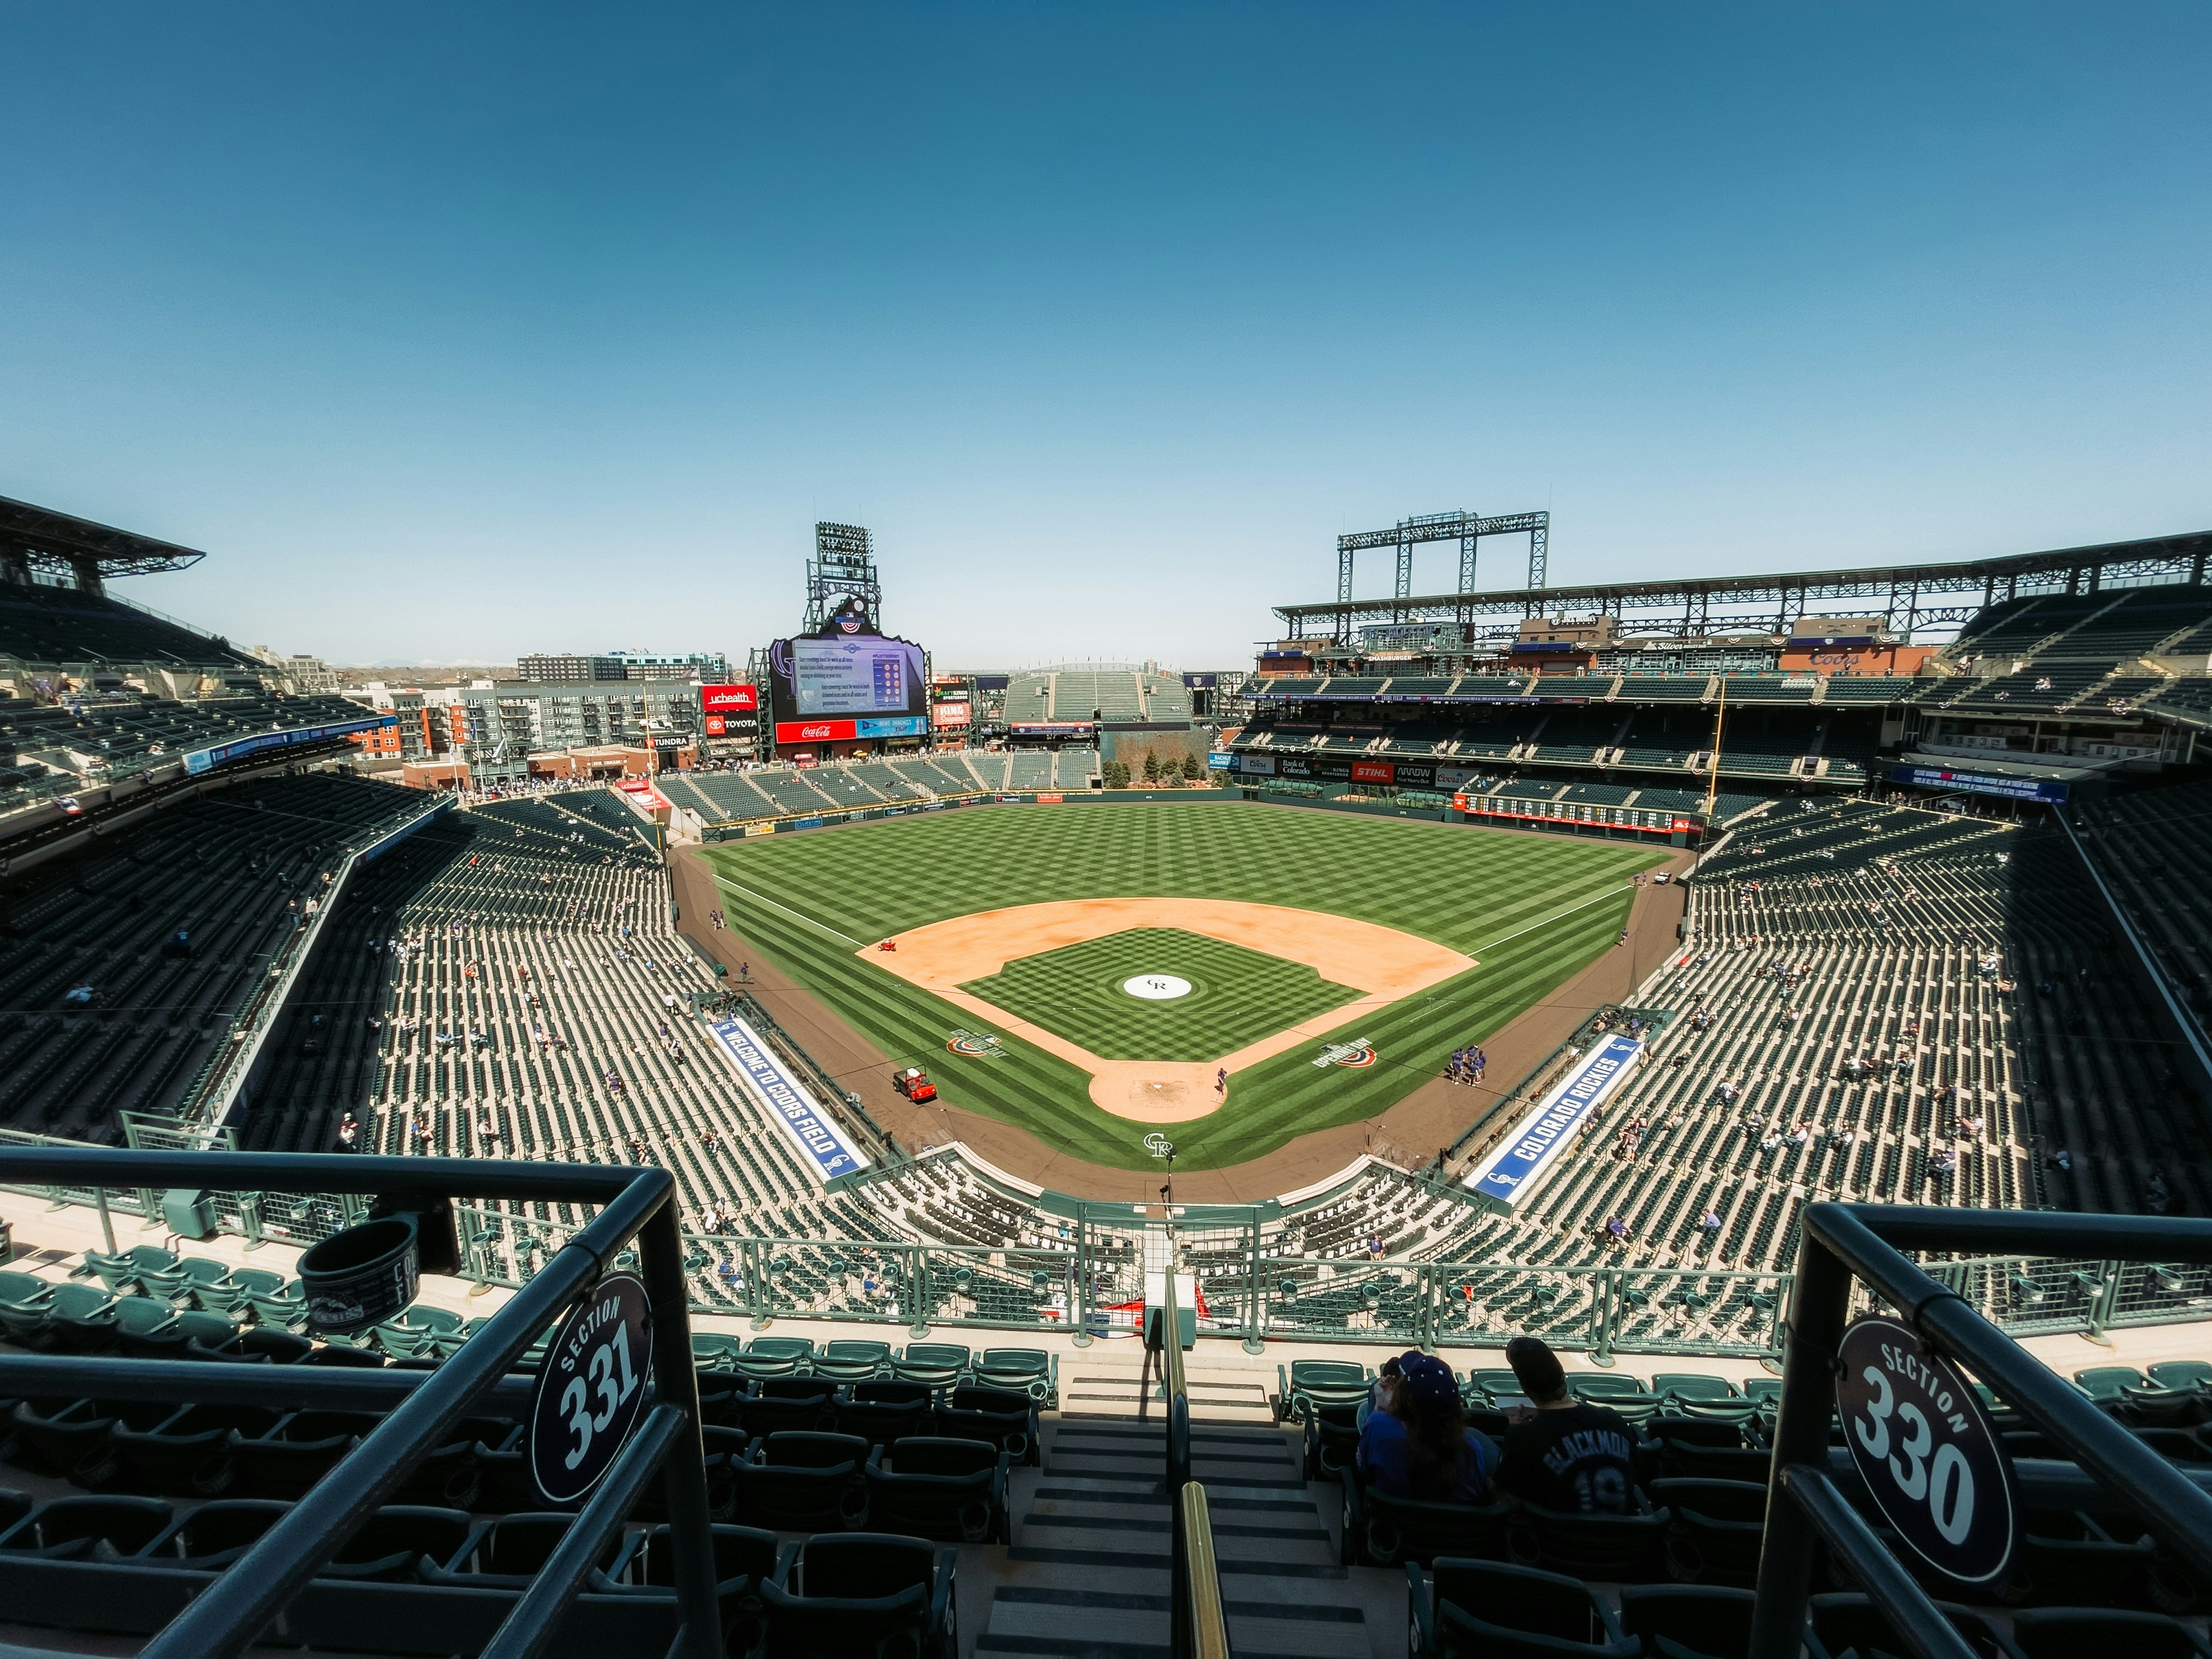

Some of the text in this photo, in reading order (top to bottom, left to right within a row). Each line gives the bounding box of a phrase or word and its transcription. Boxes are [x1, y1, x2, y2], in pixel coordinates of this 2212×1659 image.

[1657, 642, 1683, 650] Silver
[1810, 653, 1859, 666] Coors
[711, 692, 749, 702] uchealth
[940, 705, 964, 715] KING
[725, 720, 758, 728] TOYOTA
[654, 737, 687, 746] TUNDRA
[1283, 766, 1310, 775] Colorado
[1357, 768, 1388, 777] STIHL
[1437, 773, 1459, 783] Coors
[621, 781, 644, 789] uchealth
[950, 1028, 1011, 1058] OPENING DAY
[1311, 1037, 1373, 1068] OPENING DAY
[724, 1030, 837, 1154] WELCOME TO COORS FIELD
[1513, 1057, 1620, 1162] COLORADO ROCKIES
[561, 1295, 621, 1372] SECTION
[560, 1319, 639, 1471] 331
[1881, 1343, 1969, 1434] SECTION
[1542, 1430, 1630, 1477] BLACKMON
[1855, 1365, 1974, 1545] 330
